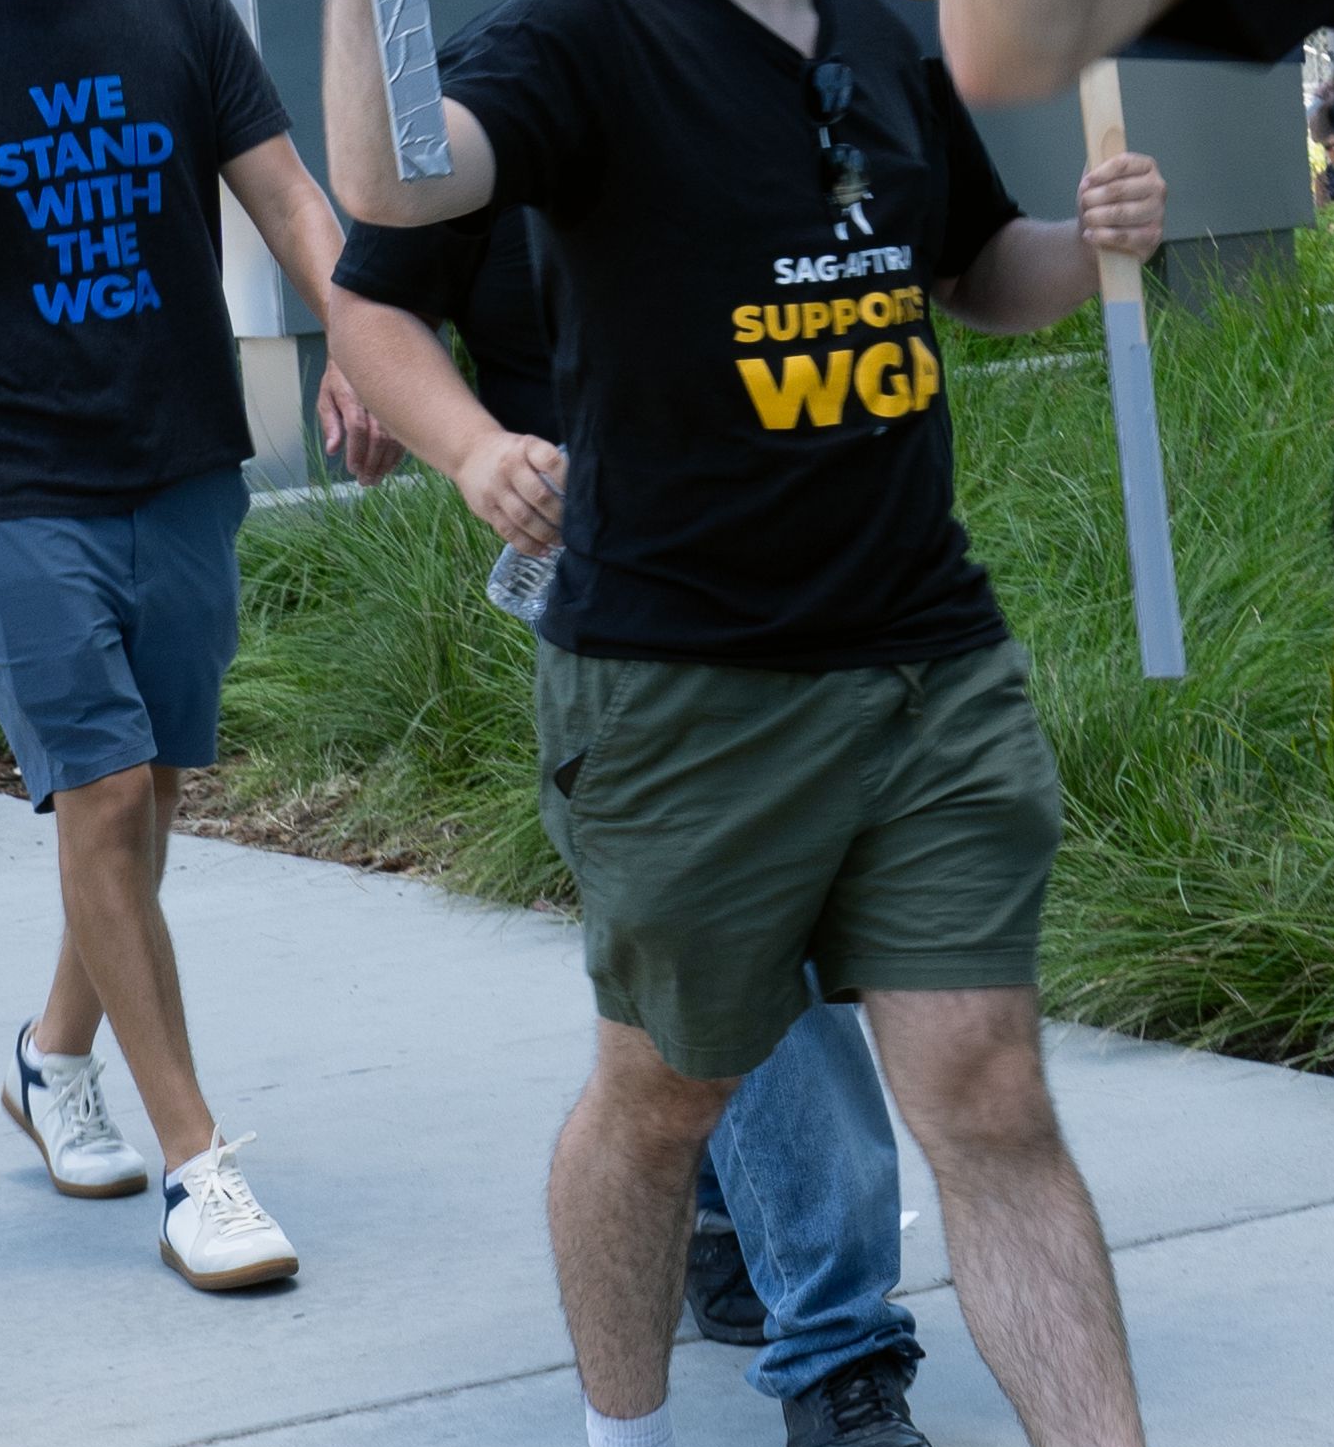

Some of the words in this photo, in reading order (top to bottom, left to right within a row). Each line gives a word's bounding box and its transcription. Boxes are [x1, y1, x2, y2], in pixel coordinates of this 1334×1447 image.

[28, 74, 126, 128] WE
[15, 171, 162, 231] WITH
[46, 222, 141, 276] THE
[32, 269, 162, 326] WGA
[735, 336, 940, 431] WGA
